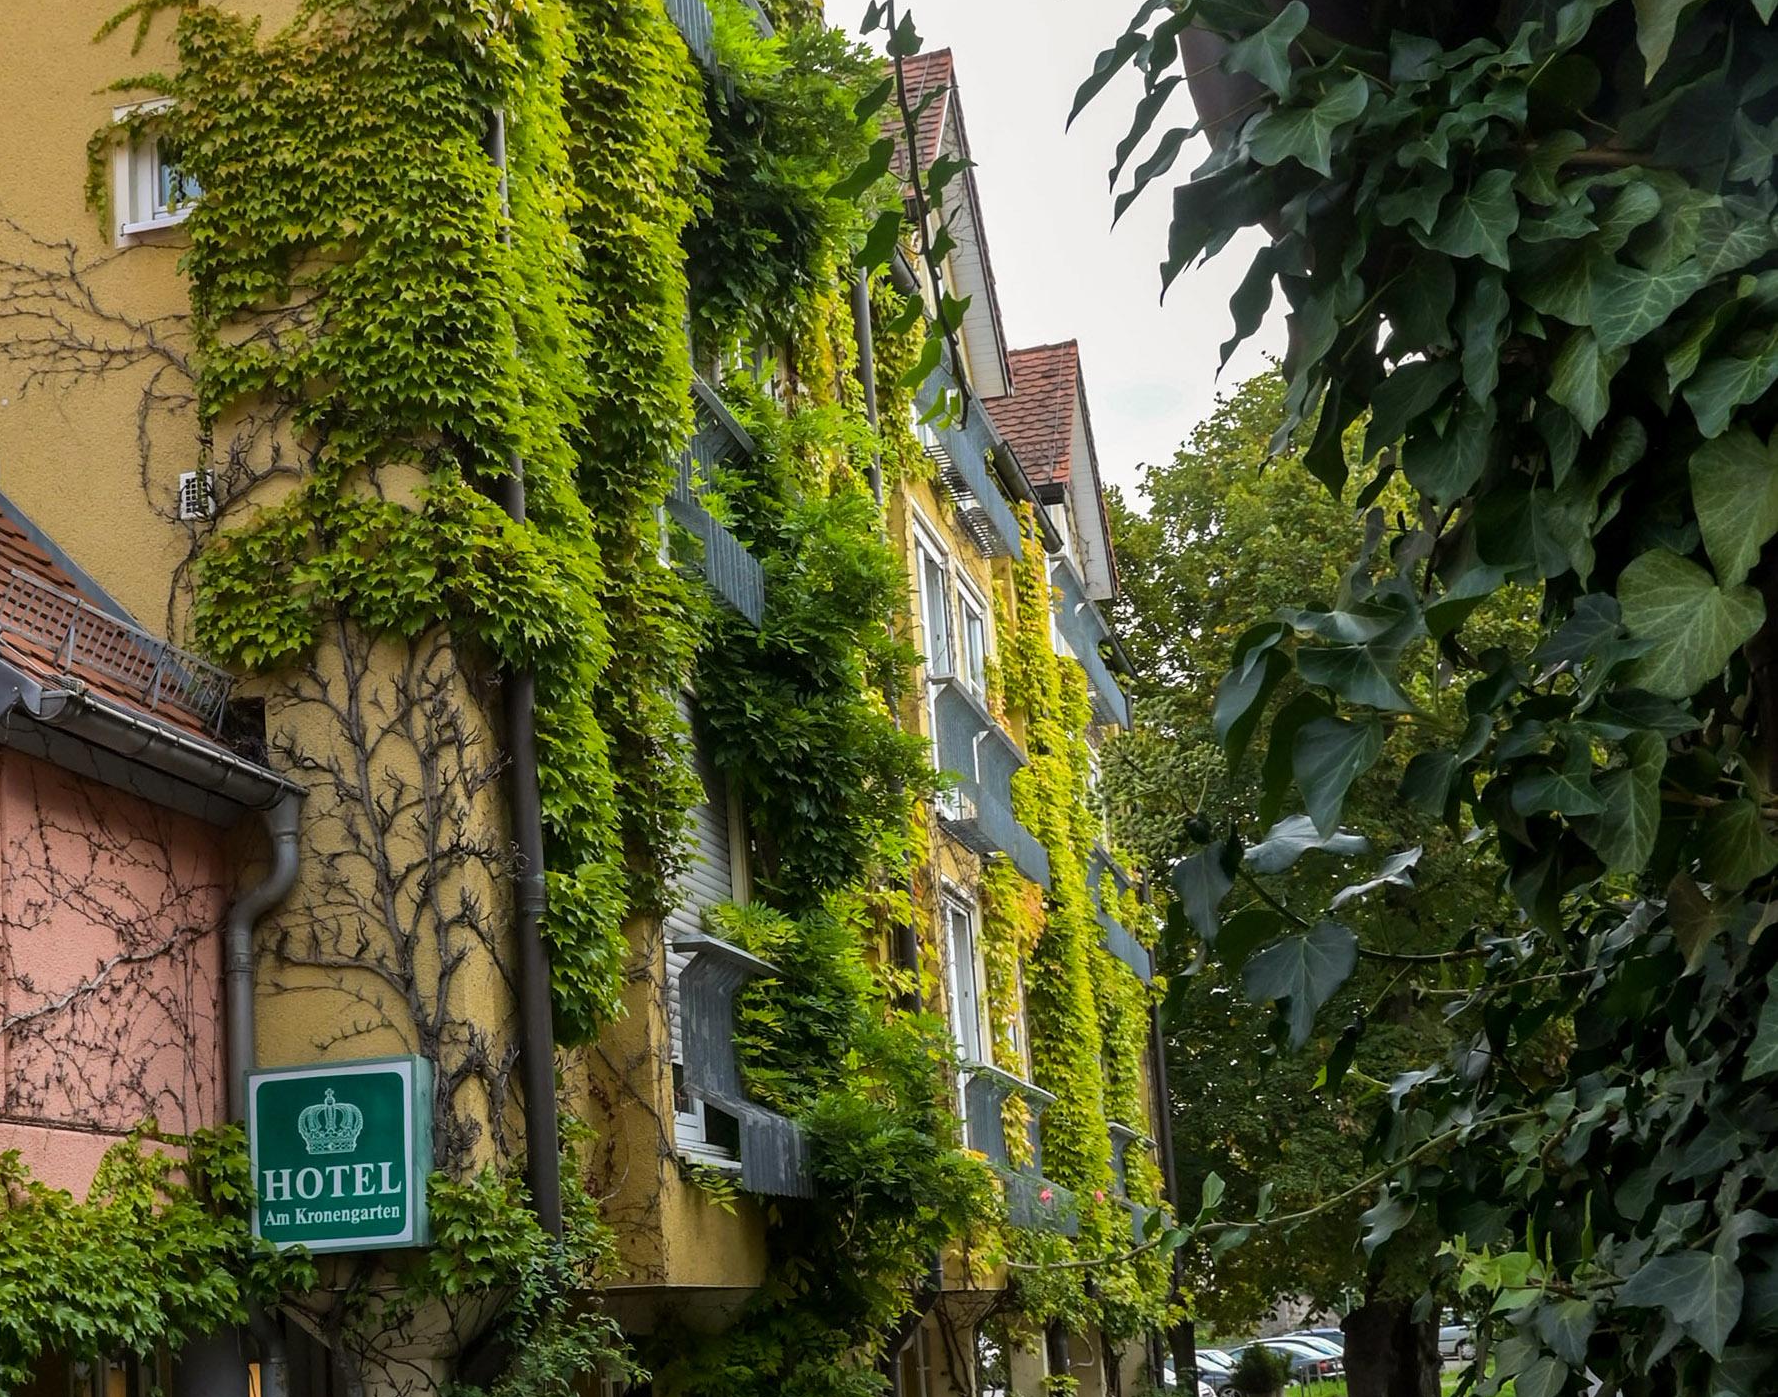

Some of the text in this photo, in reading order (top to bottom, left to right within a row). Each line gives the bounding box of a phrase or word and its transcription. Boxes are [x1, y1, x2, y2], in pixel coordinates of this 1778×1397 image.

[262, 1161, 402, 1202] HOTEL
[264, 1204, 400, 1227] Am Kronengarten
